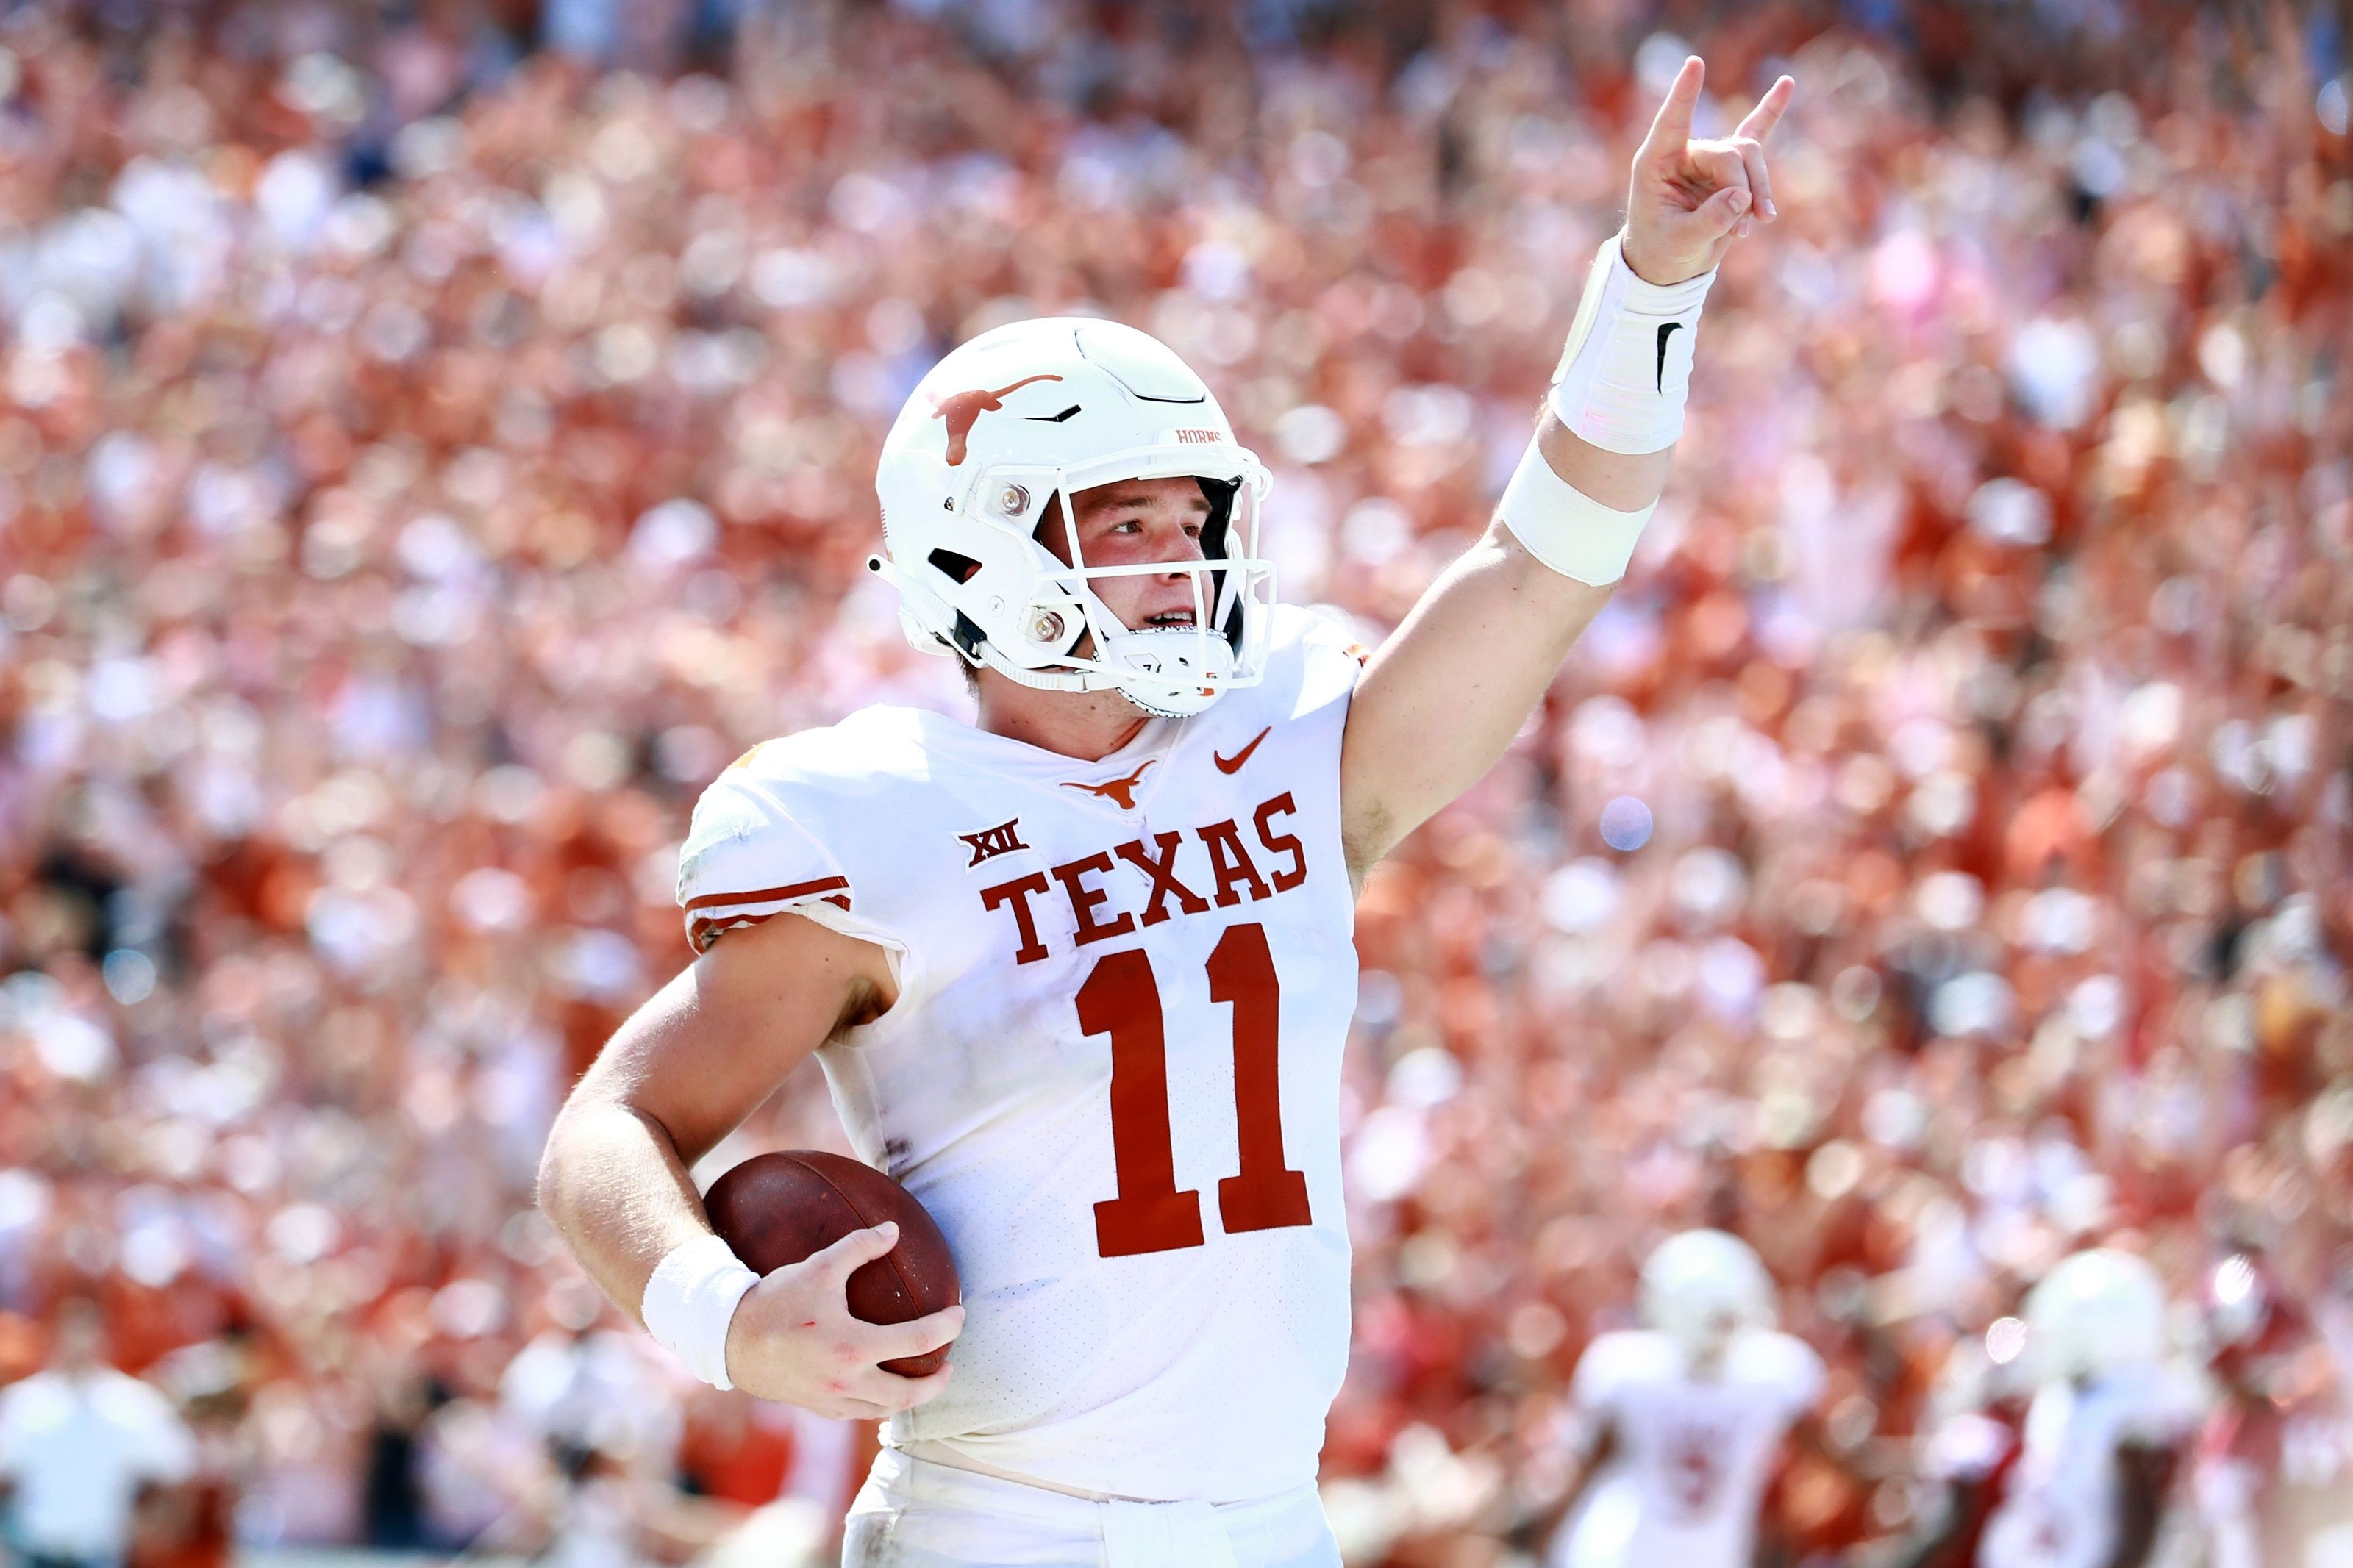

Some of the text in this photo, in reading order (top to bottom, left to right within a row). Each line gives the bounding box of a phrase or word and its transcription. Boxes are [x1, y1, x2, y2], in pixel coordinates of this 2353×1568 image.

[1176, 429, 1222, 443] HORNS
[958, 817, 1030, 868] XII
[980, 791, 1307, 965] TEXAS
[1075, 922, 1312, 1258] 11
